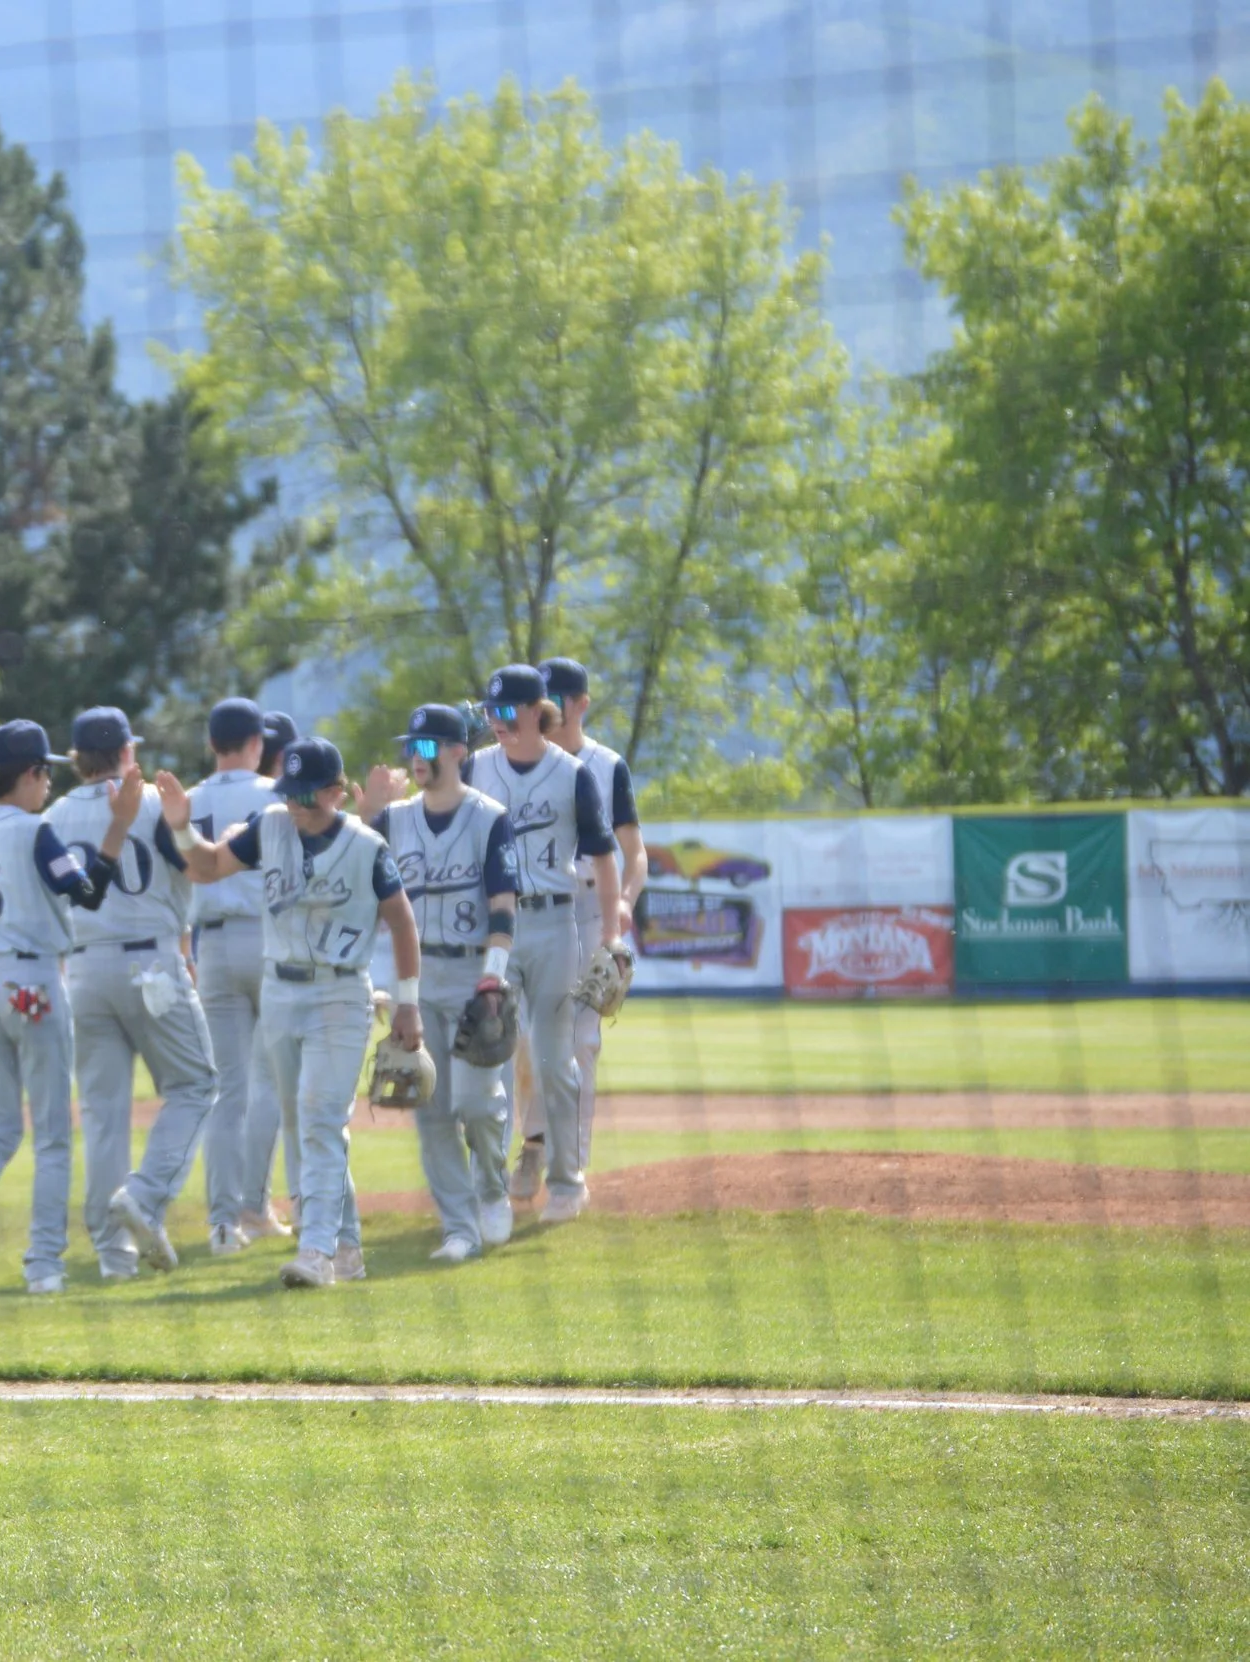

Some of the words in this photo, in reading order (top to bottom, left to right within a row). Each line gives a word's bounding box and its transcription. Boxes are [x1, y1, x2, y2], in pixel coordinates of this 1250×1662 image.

[398, 851, 482, 884] Bucs
[537, 838, 558, 869] 4
[265, 867, 347, 901] Bucs
[453, 900, 477, 933] 8
[1065, 905, 1121, 933] Bank
[315, 920, 363, 959] 17
[798, 922, 934, 980] MONTANA
